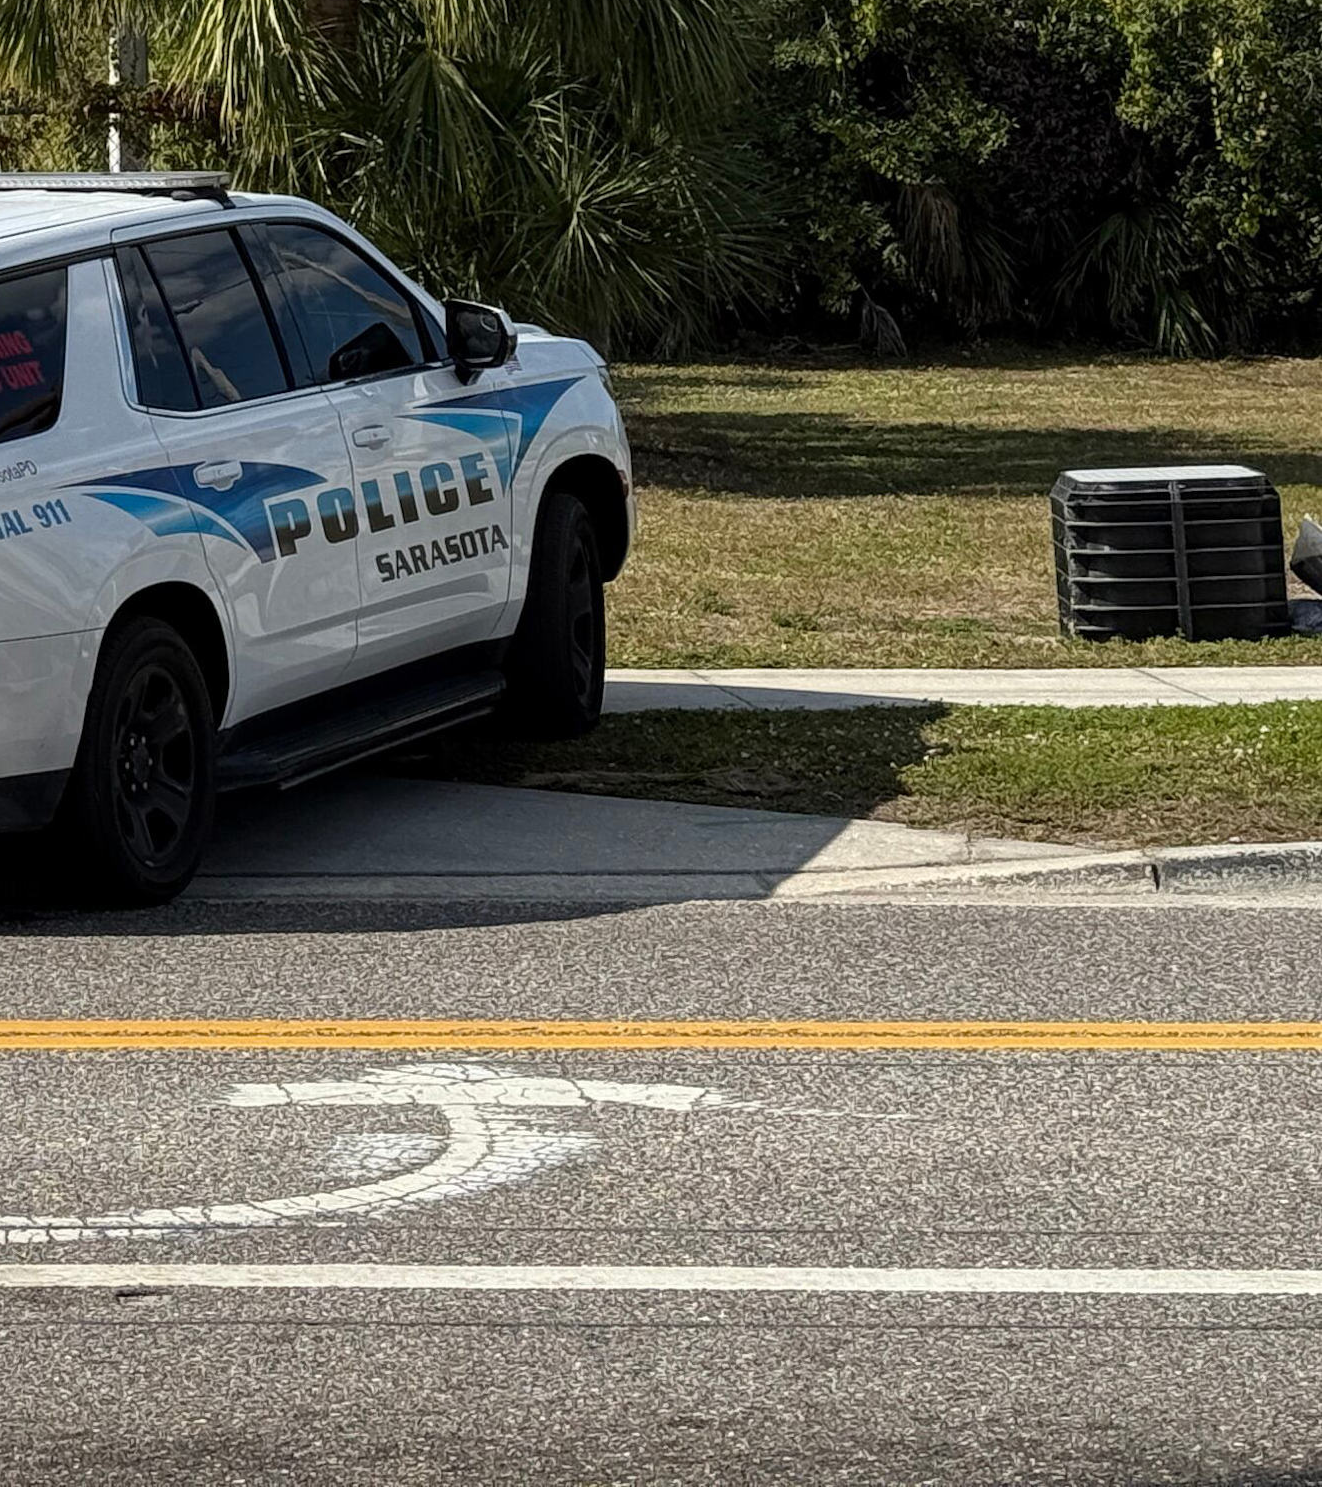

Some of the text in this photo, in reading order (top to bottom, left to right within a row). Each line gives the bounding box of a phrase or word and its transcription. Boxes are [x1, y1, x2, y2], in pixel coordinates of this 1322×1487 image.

[0, 360, 45, 391] UNIT
[32, 498, 72, 529] 911
[268, 451, 495, 559] POLICE
[375, 524, 510, 583] SARASOTA
